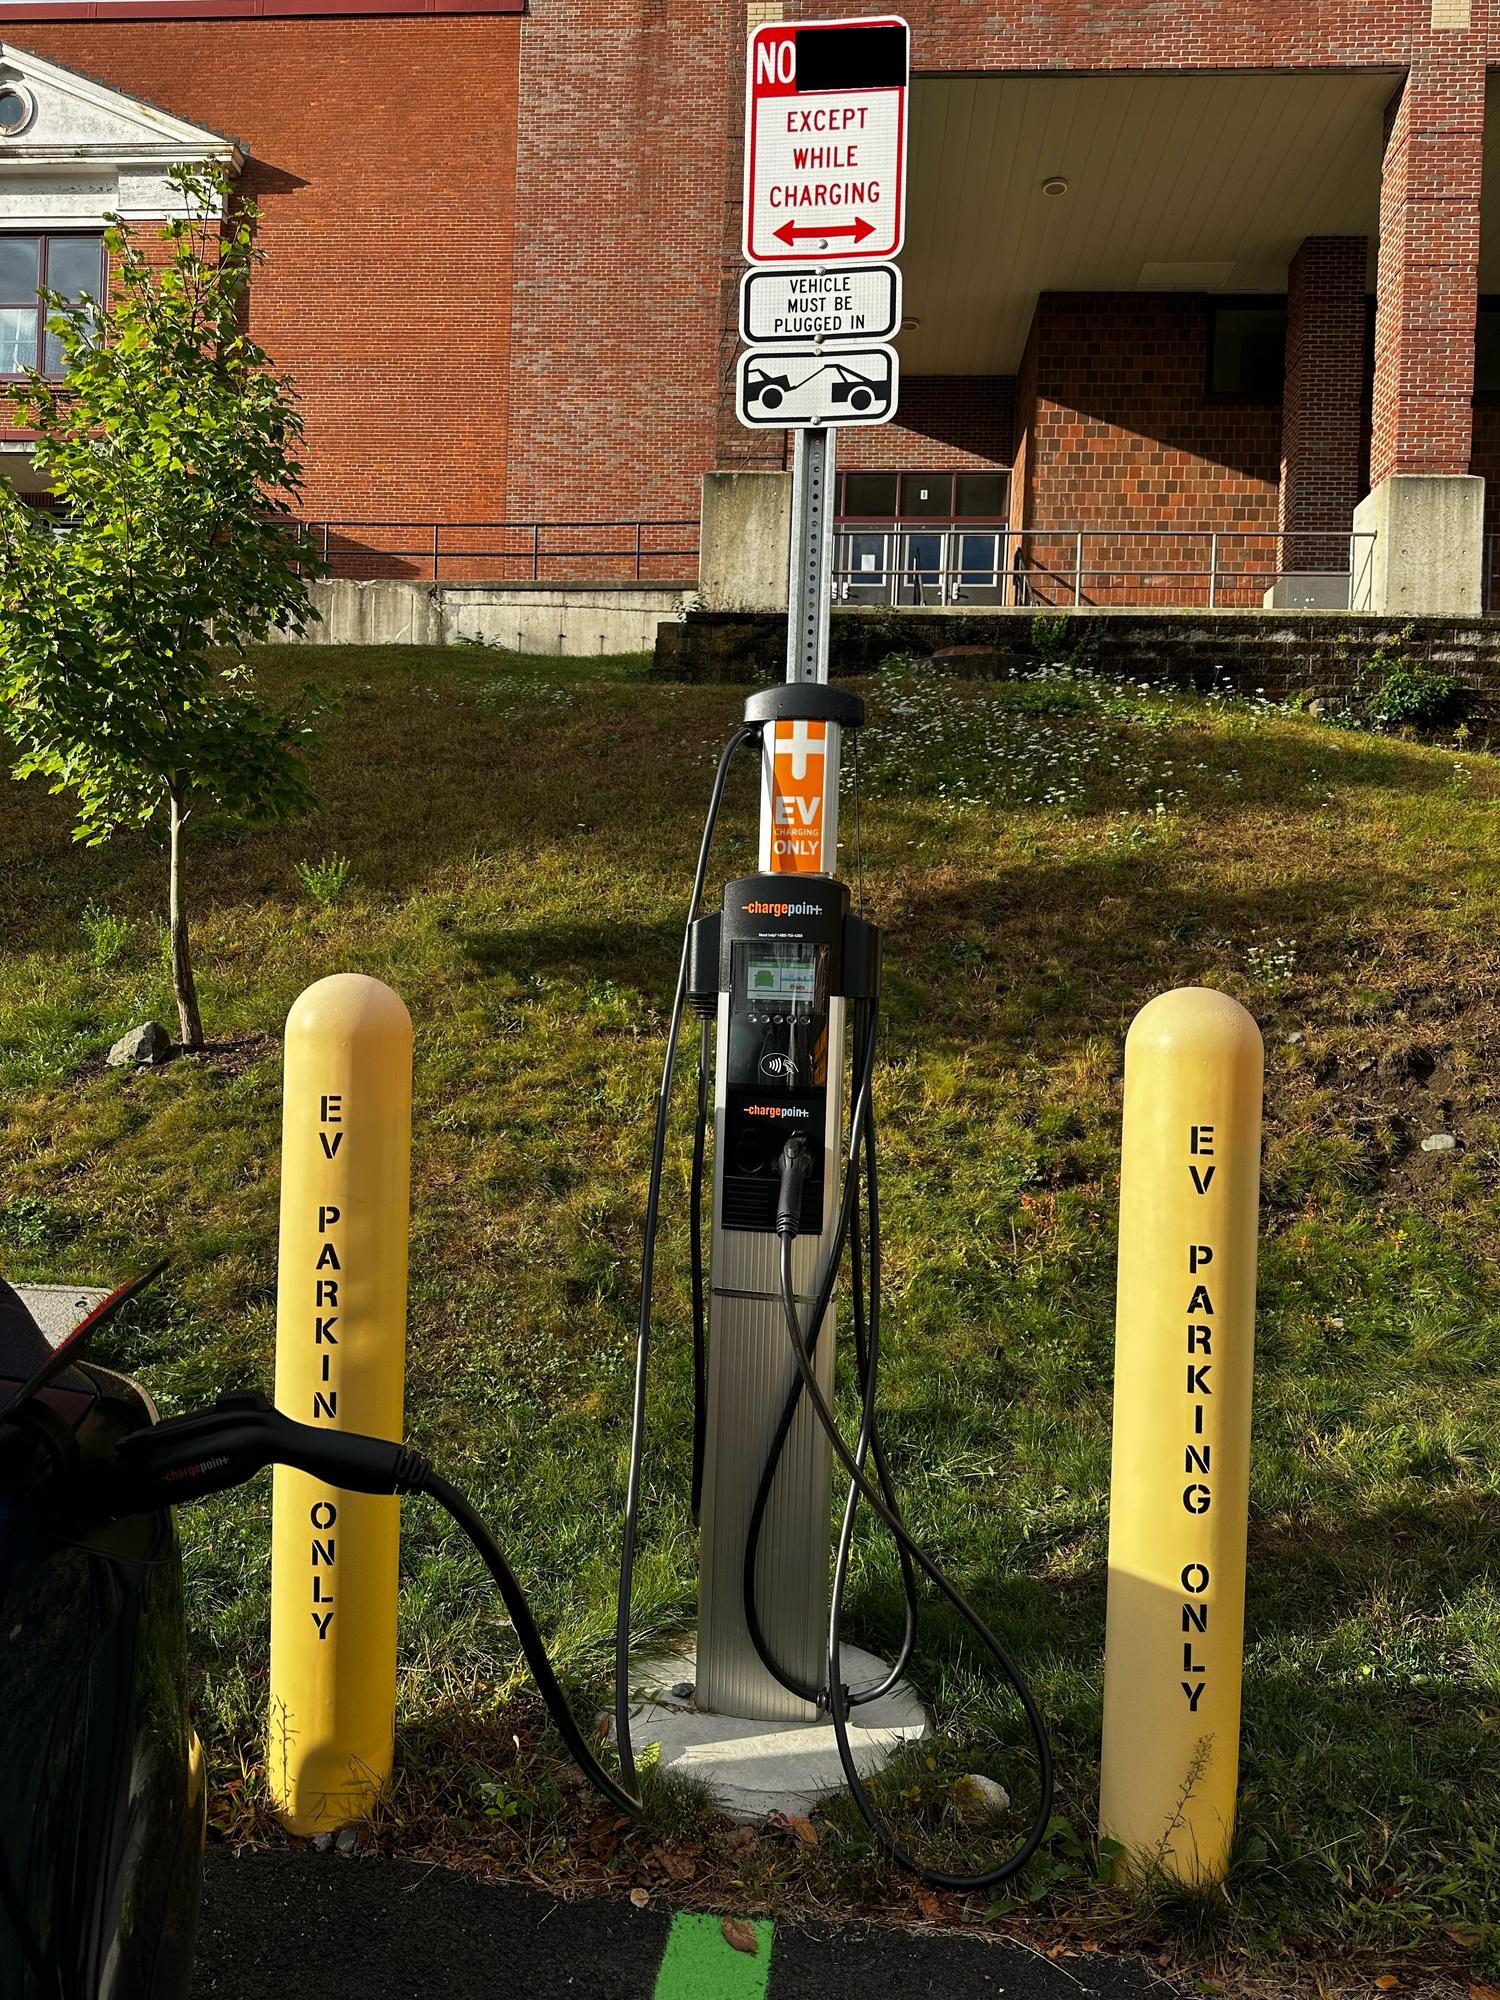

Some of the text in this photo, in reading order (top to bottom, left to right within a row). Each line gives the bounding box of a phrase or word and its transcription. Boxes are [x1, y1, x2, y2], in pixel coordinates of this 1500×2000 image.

[757, 40, 796, 84] NO
[786, 107, 868, 133] EXCEPT
[793, 145, 858, 169] WHILE
[769, 181, 880, 208] CHARGING
[789, 277, 851, 293] VEHICLE
[787, 296, 852, 313] MUST BE
[774, 315, 865, 333] PLUGGED IN
[775, 796, 821, 825] EV
[774, 828, 819, 836] CHARGING
[773, 840, 819, 855] ONLY
[310, 1095, 344, 1640] EV PARKIN ONLY
[1181, 1126, 1216, 1712] EV PARKING ONLY
